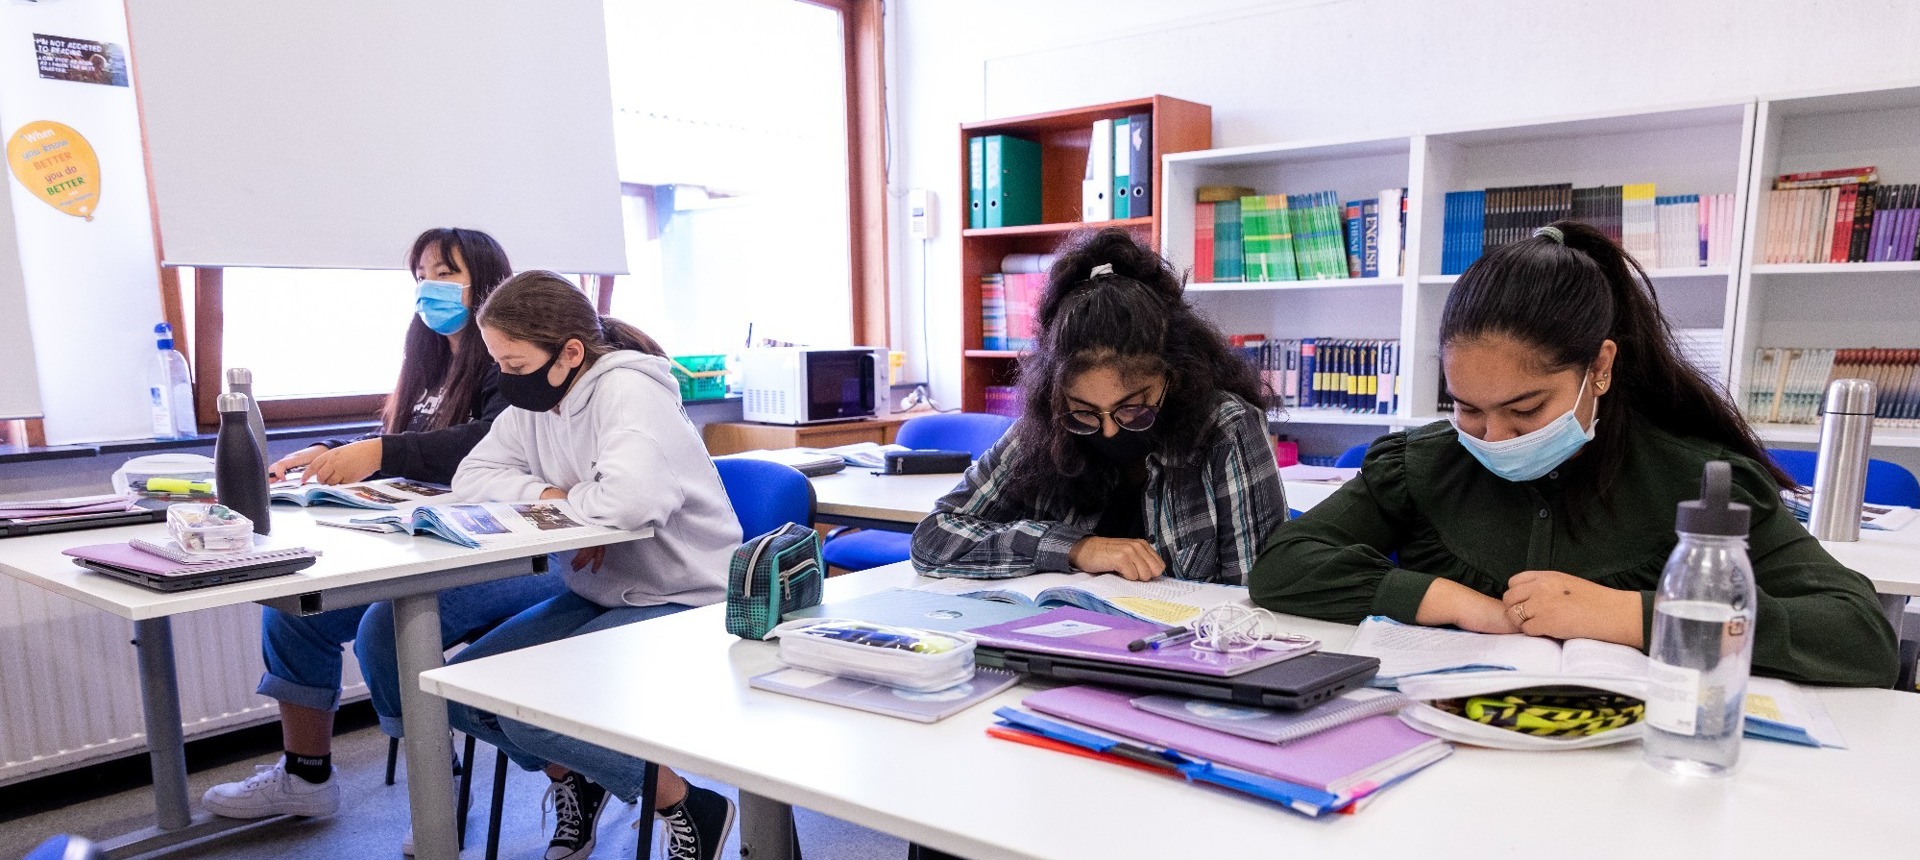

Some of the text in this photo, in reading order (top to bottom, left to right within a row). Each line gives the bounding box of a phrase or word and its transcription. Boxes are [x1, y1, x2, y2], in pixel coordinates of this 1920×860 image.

[67, 42, 102, 52] ADDICTED
[23, 140, 68, 160] you know
[33, 152, 72, 170] BETTER
[45, 165, 77, 184] you do
[46, 177, 85, 196] BETTER
[1365, 216, 1379, 272] ENGLISH
[297, 757, 323, 766] PUMA
